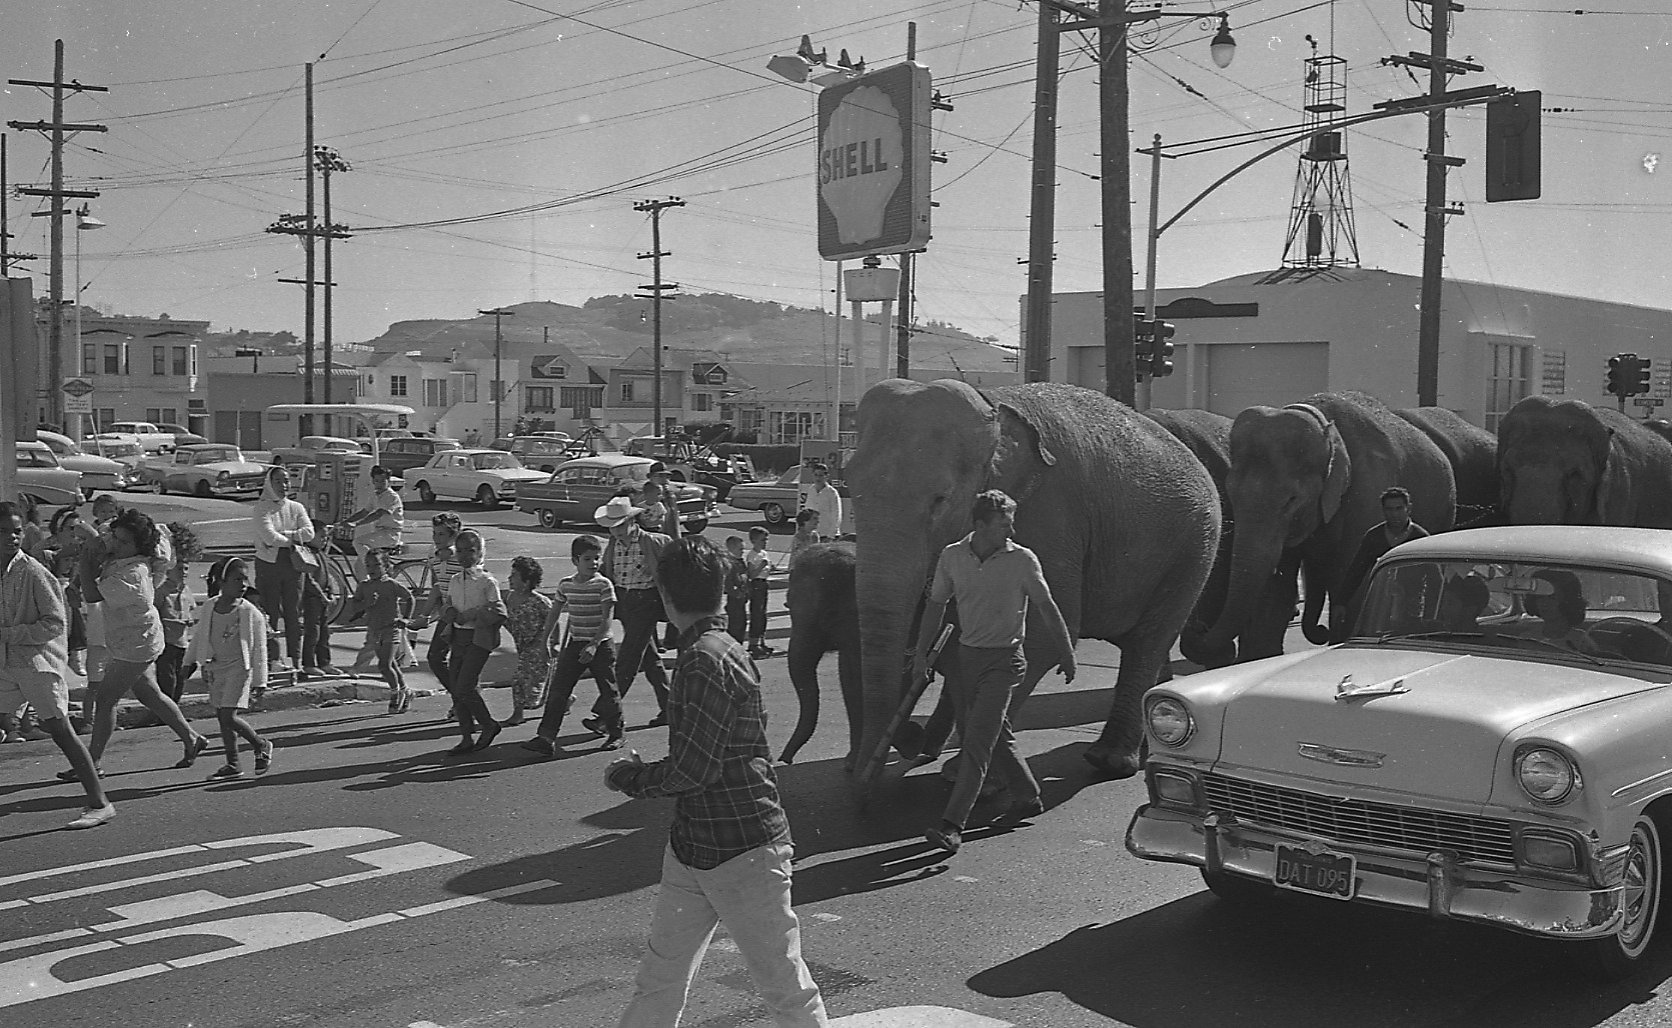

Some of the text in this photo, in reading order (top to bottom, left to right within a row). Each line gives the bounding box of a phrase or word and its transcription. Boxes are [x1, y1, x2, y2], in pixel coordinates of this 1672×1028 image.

[821, 137, 887, 185] SHELL
[1279, 859, 1349, 891] DAT 095
